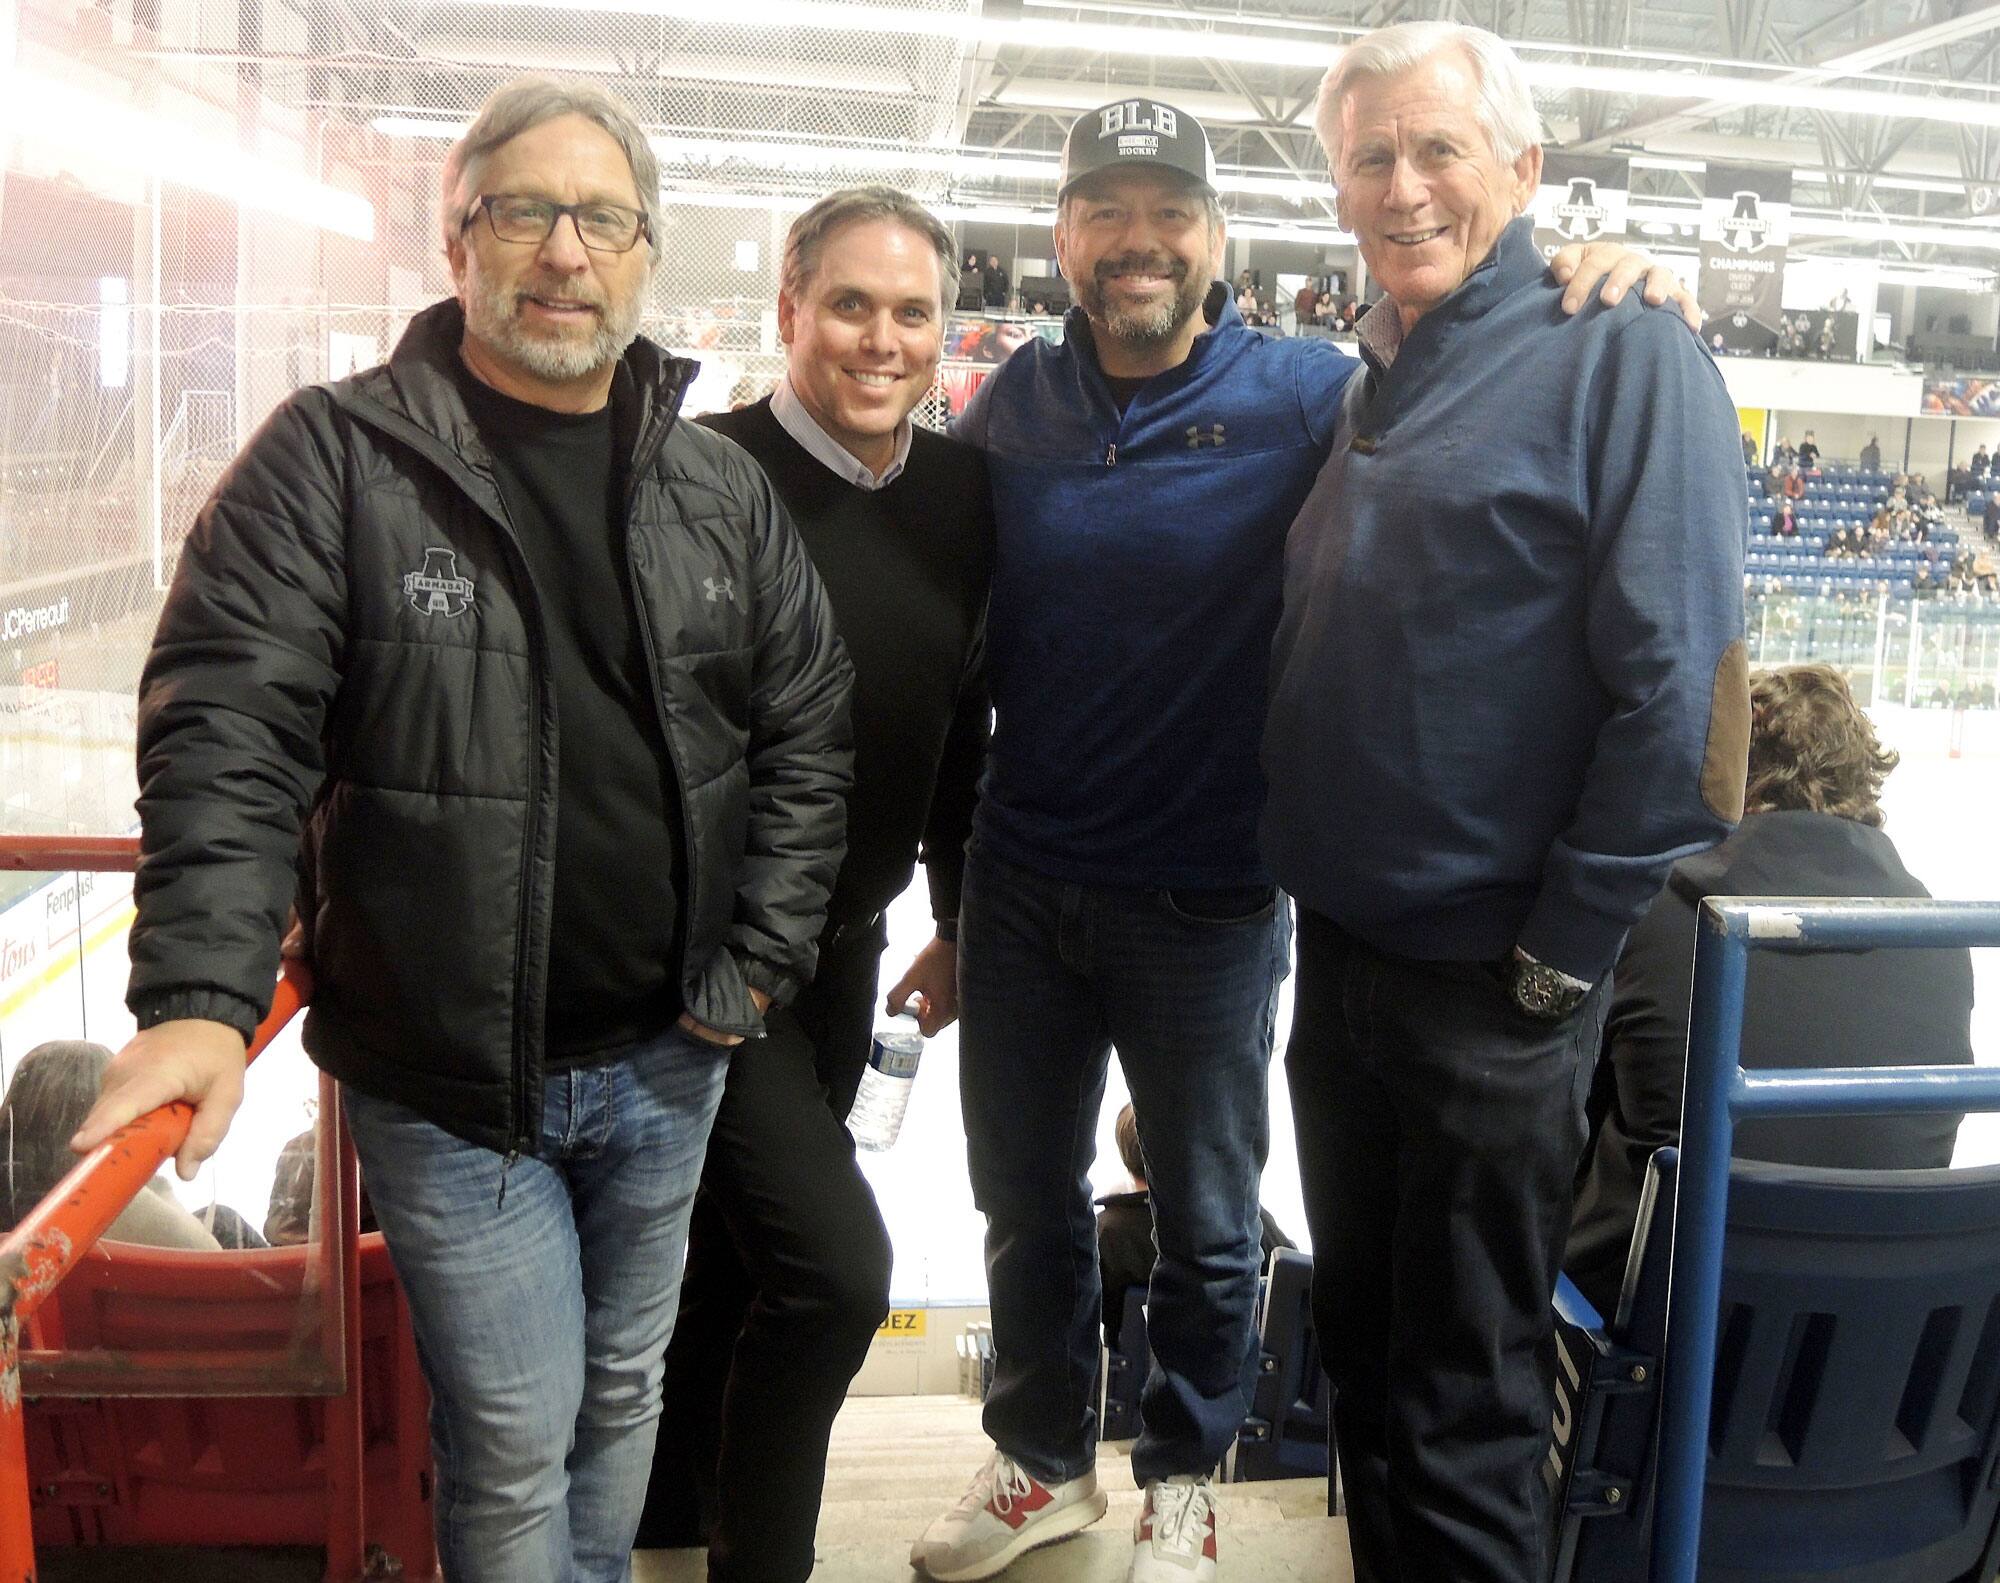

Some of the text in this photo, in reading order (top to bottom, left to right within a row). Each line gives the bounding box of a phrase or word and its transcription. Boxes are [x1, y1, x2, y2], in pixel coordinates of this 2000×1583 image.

[1119, 147, 1158, 156] HOCKEY
[1709, 257, 1776, 273] CHAMPIONS
[417, 579, 462, 592] ARMADA
